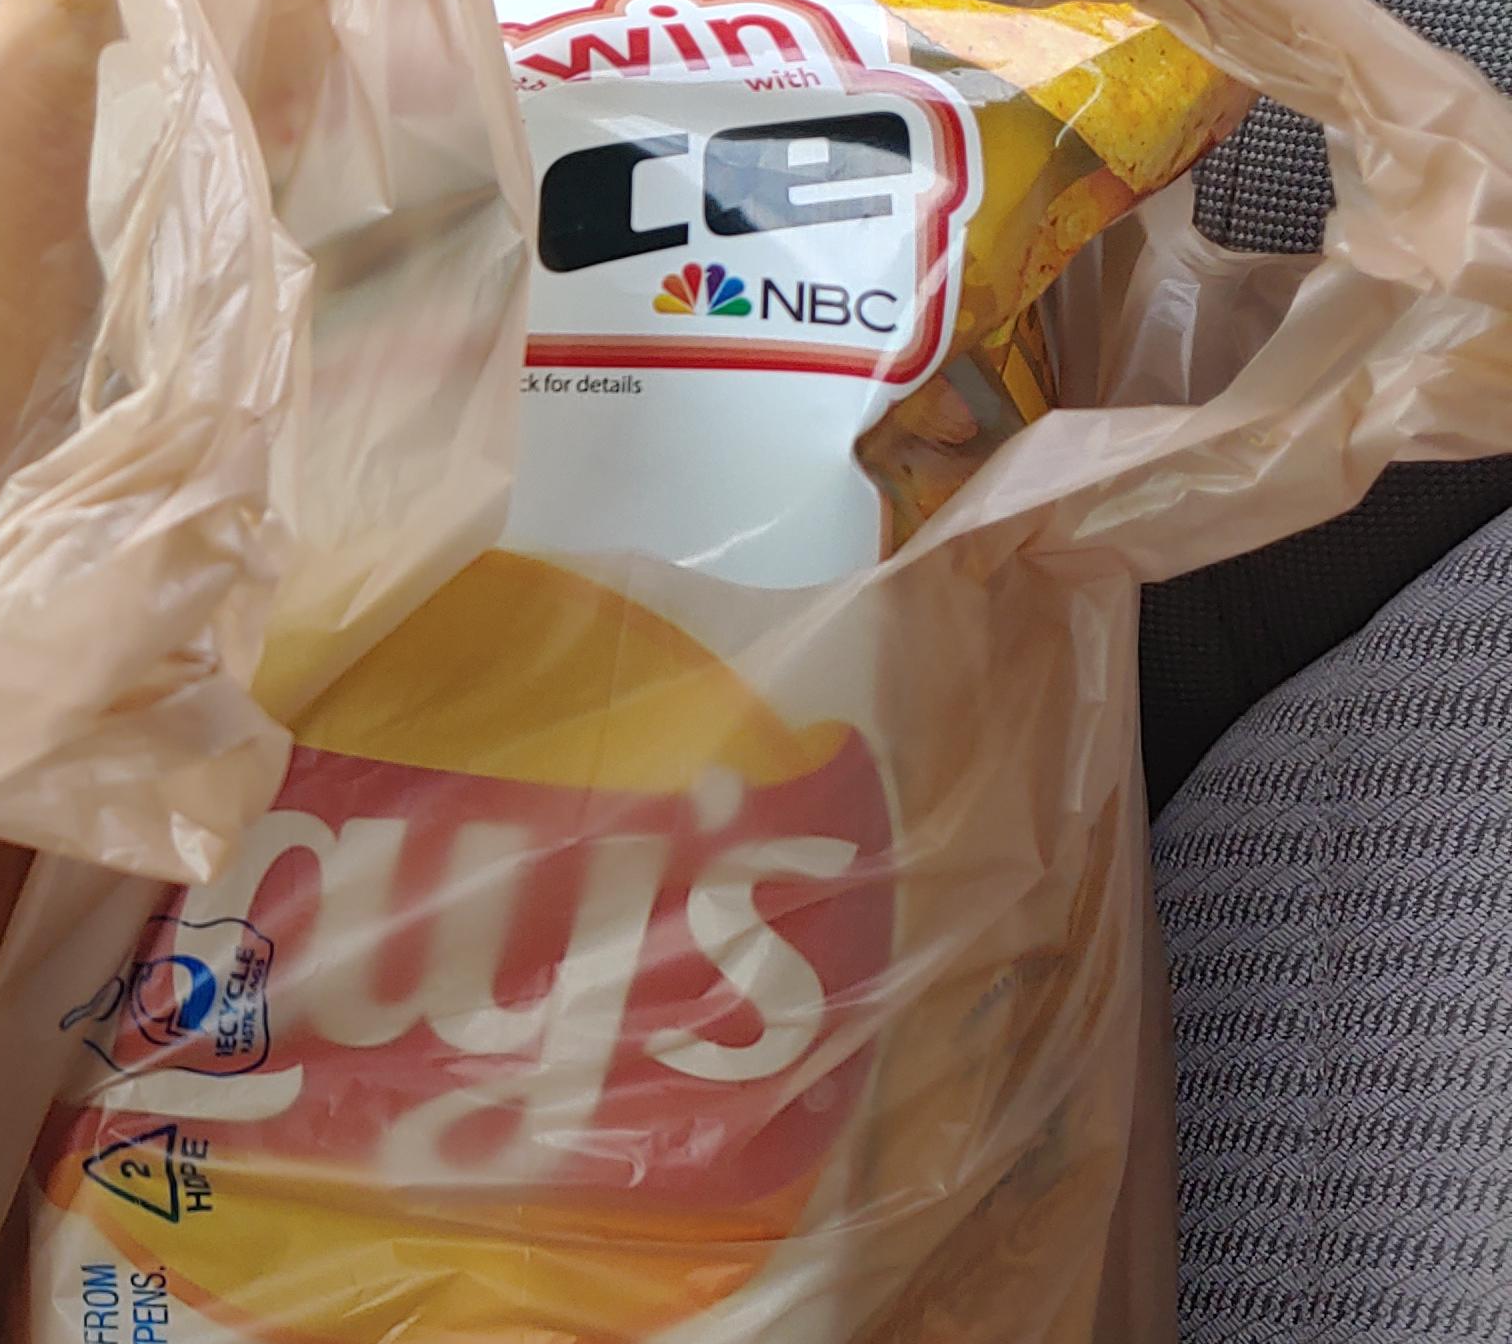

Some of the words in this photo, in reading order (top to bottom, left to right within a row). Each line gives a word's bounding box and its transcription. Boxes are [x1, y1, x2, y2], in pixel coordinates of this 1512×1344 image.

[514, 3, 807, 82] win
[743, 66, 822, 93] with
[760, 276, 899, 334] NBC
[544, 372, 571, 393] for
[576, 372, 643, 394] details
[119, 1158, 152, 1180] 2
[180, 1135, 213, 1214] HDPE
